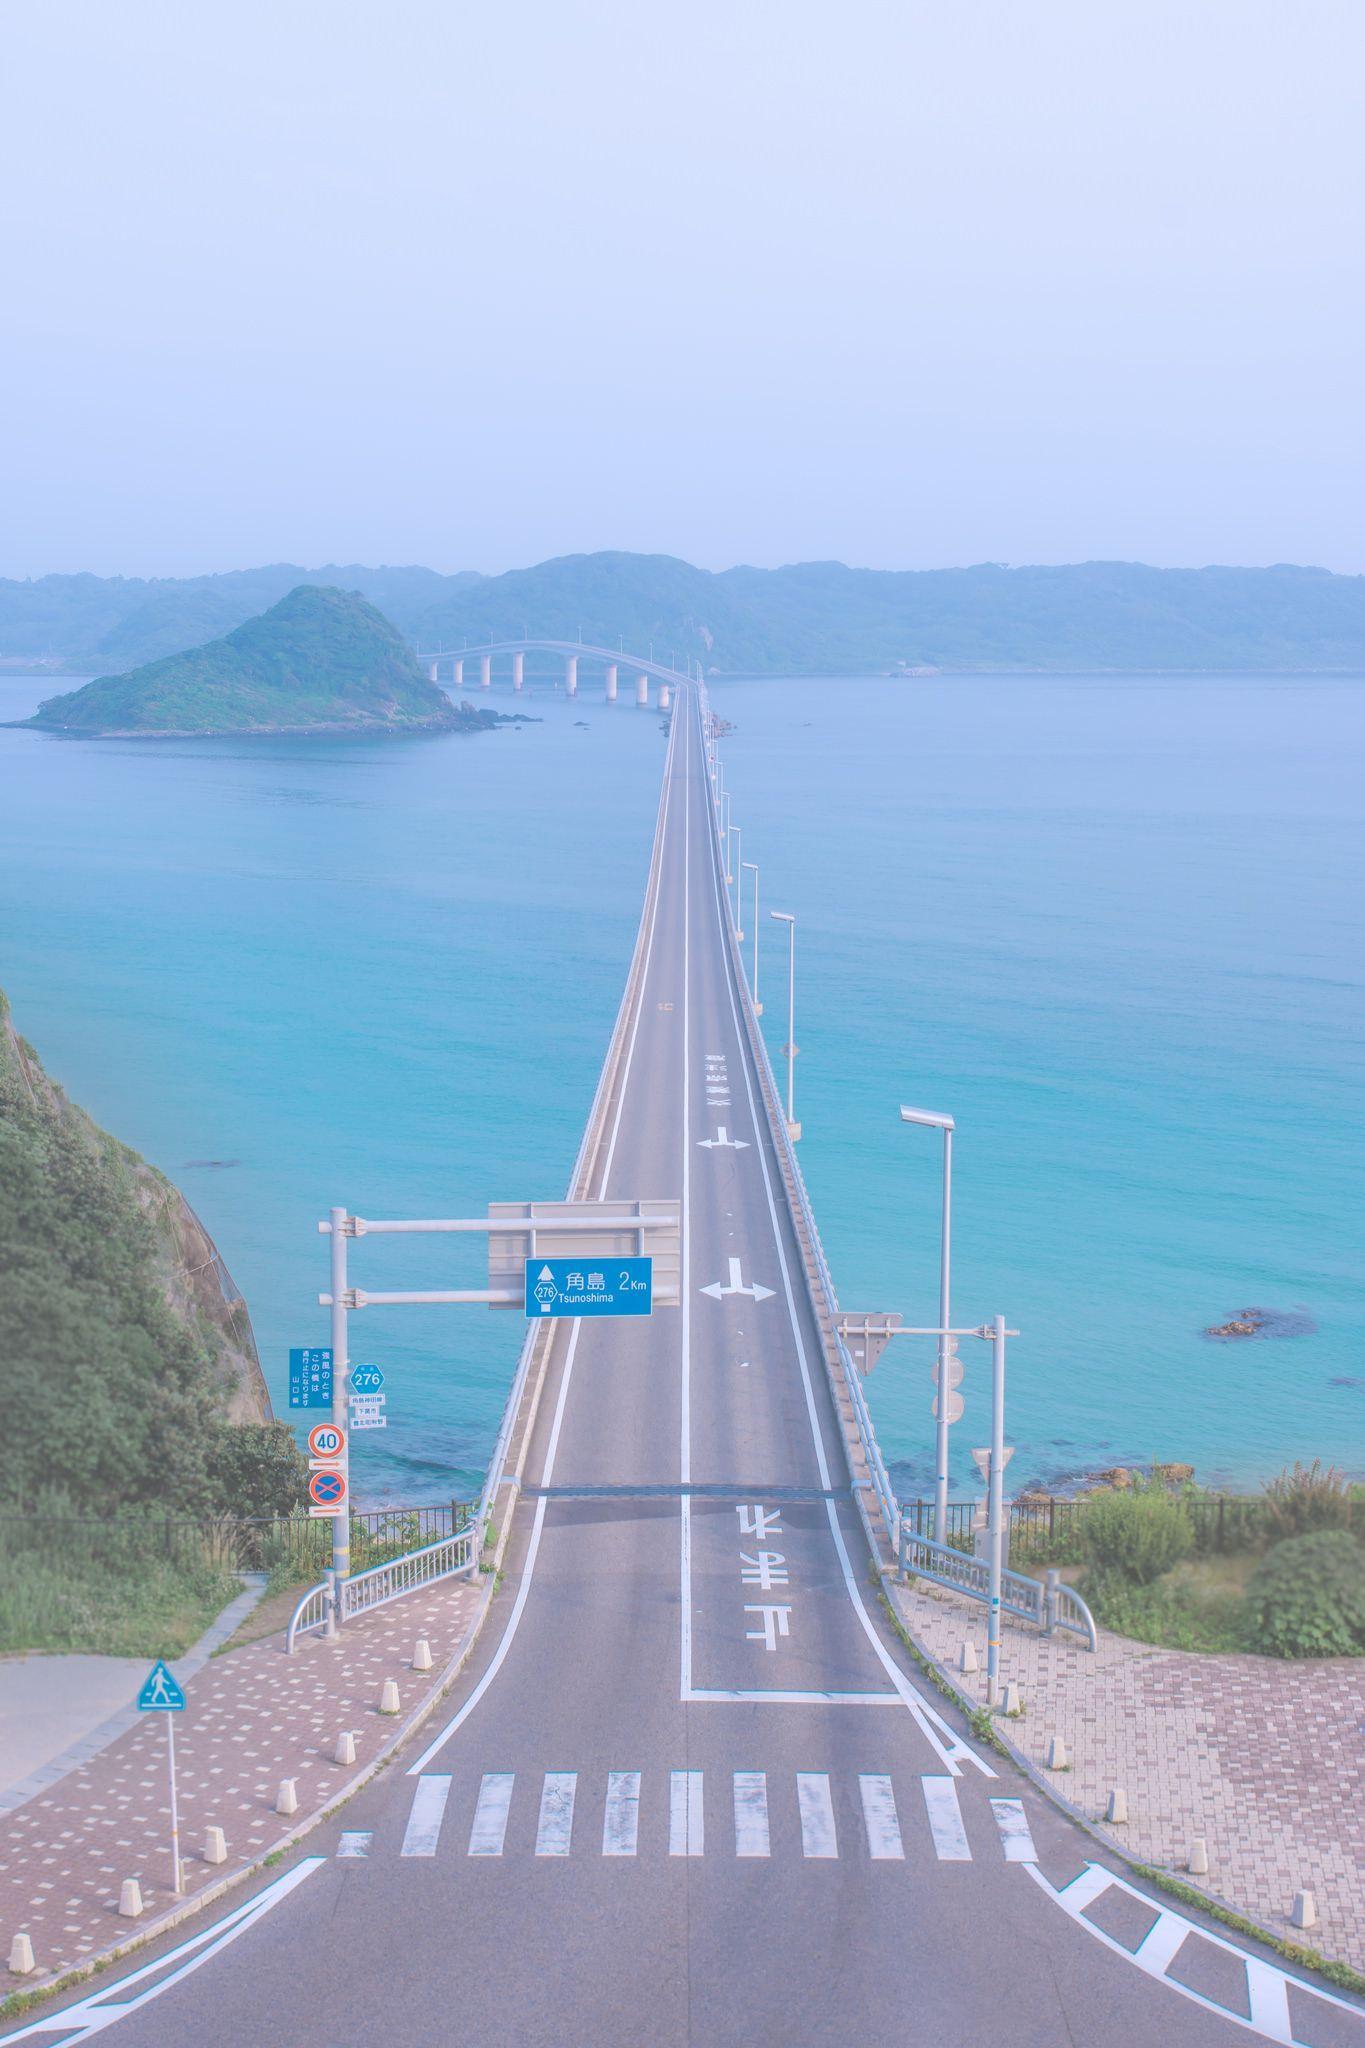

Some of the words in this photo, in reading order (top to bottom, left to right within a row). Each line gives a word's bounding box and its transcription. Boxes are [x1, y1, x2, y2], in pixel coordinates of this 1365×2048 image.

[566, 1272, 605, 1291] 角島
[538, 1287, 554, 1298] 276
[558, 1293, 614, 1303] Tsunoshima
[355, 1373, 380, 1386] 276
[317, 1433, 337, 1449] 40
